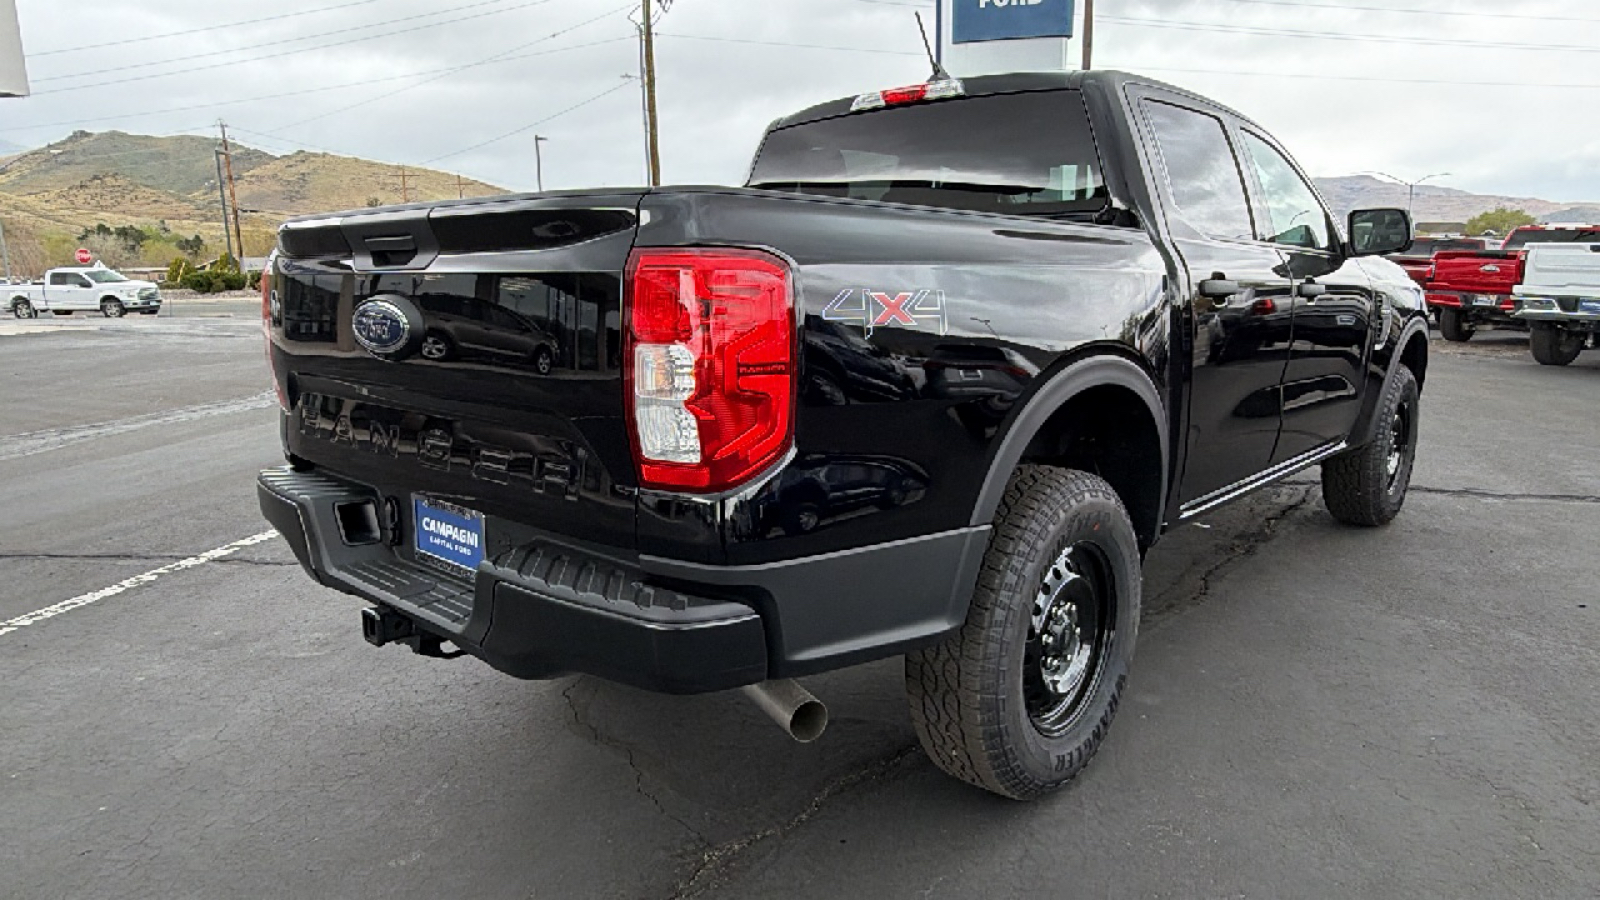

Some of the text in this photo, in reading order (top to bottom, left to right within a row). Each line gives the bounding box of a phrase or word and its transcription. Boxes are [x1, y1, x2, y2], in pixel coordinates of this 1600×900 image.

[300, 394, 580, 500] RANGER
[422, 517, 478, 548] CAMPAGNI
[429, 536, 472, 555] CAPITAL FORD
